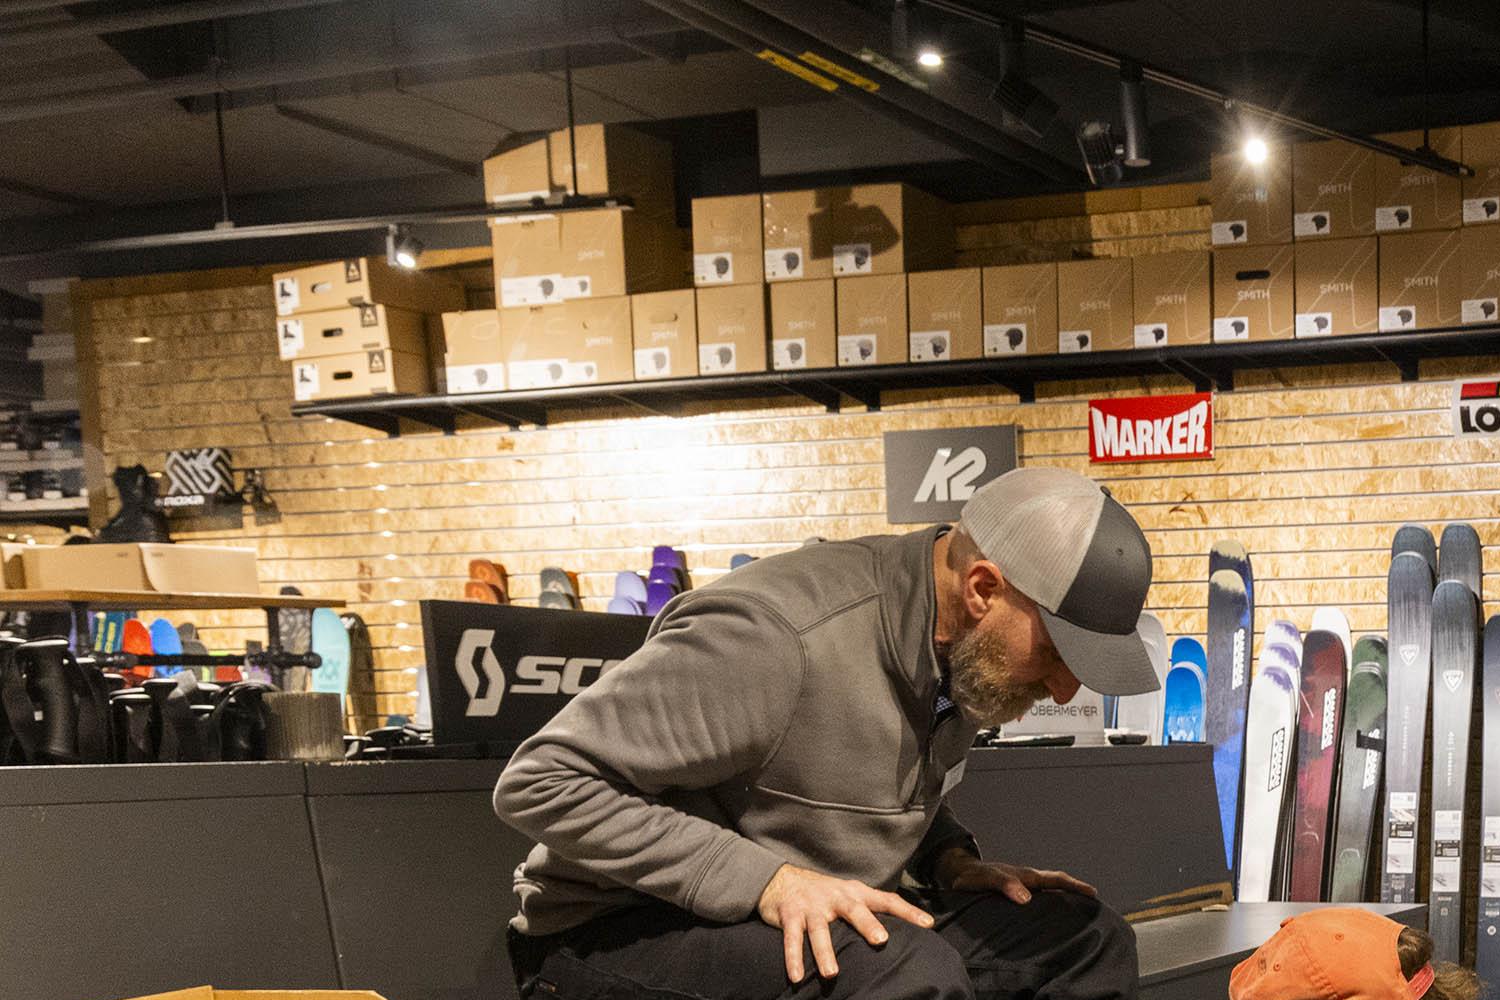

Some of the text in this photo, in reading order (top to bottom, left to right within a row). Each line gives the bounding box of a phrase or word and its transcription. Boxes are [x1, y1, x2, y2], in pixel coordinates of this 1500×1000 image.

[1400, 175, 1437, 187] SMITH
[1318, 184, 1351, 196] SMITH
[1319, 283, 1353, 294] SMITH
[1402, 276, 1439, 289] SMITH
[1155, 294, 1187, 306] SMITH
[1237, 290, 1271, 301] SMITH
[1005, 305, 1036, 318] SMITH
[1079, 300, 1111, 311] SMITH
[1086, 400, 1210, 458] MARKER
[913, 446, 988, 502] K2
[1030, 704, 1099, 718] OBERMEYER
